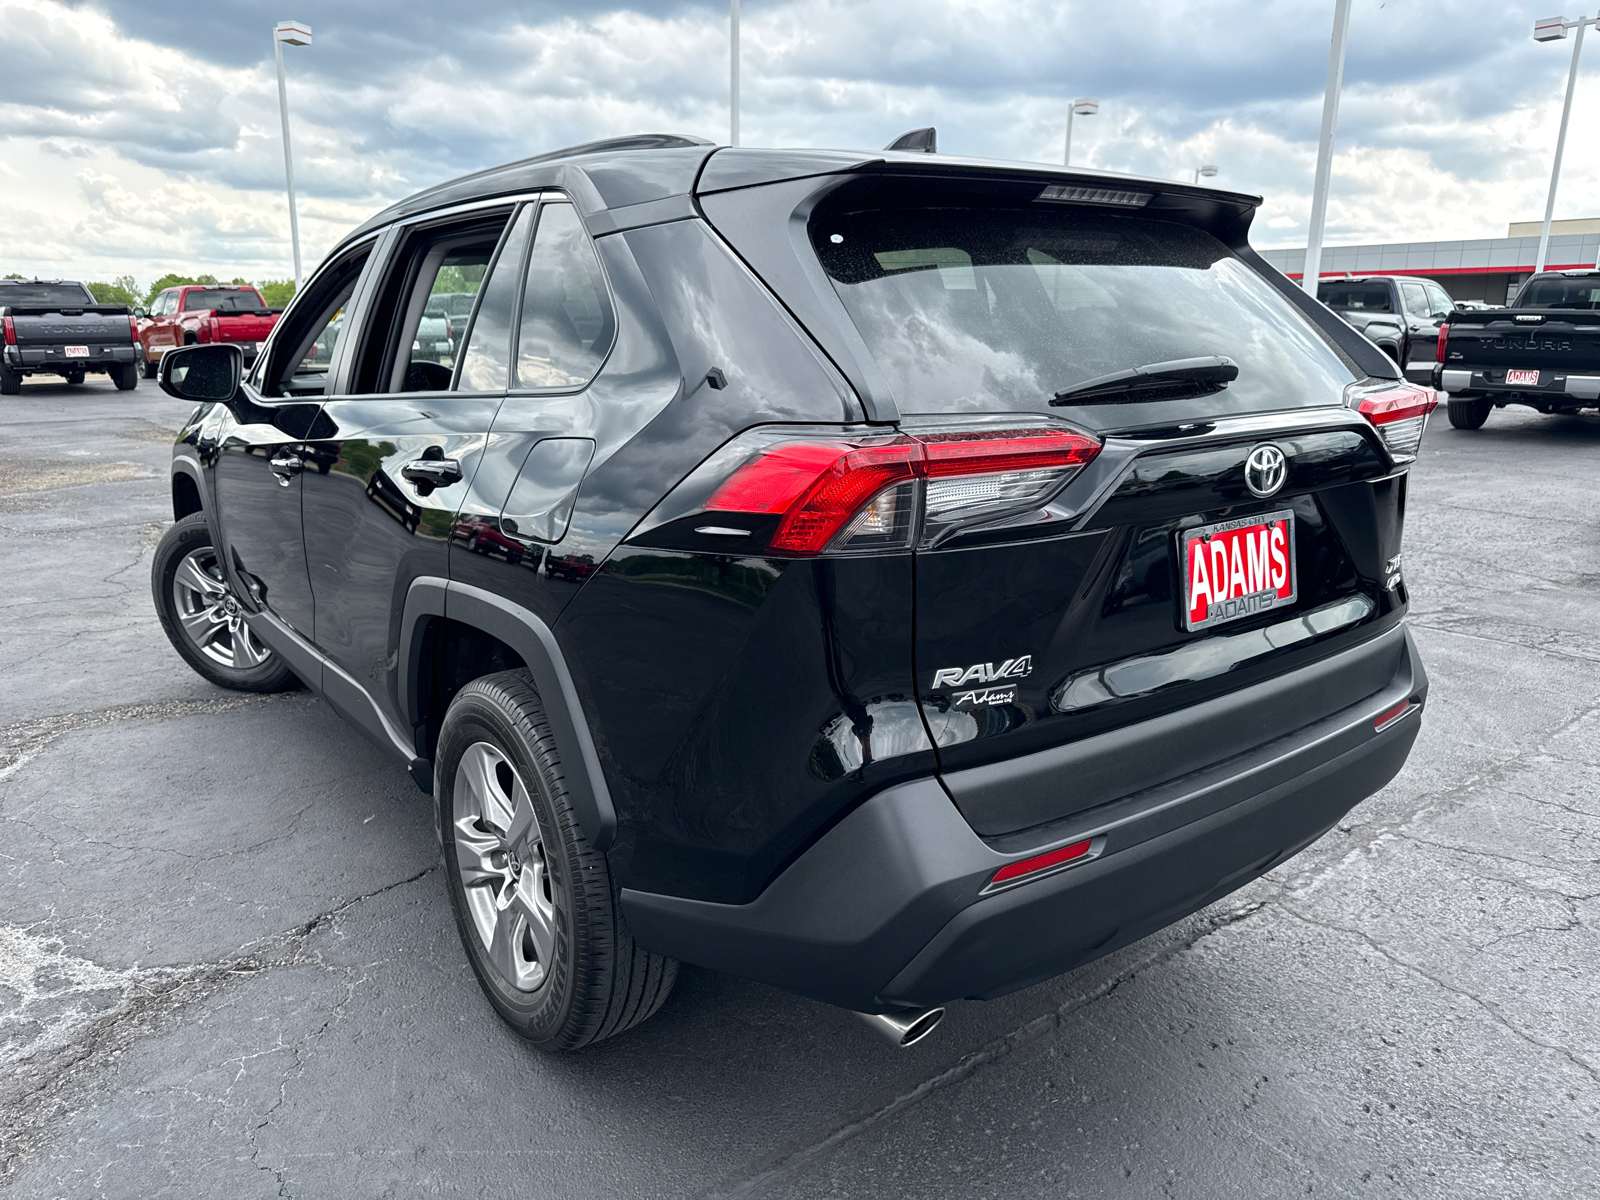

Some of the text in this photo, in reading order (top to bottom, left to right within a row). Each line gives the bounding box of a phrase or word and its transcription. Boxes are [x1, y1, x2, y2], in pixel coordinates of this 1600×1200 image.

[40, 325, 108, 334] TUNDRA
[1479, 337, 1572, 351] TUNDRA
[1508, 370, 1538, 384] ADAMS
[1213, 515, 1267, 533] KANSAS CITY
[1190, 526, 1287, 611] ADAMS
[1213, 590, 1274, 622] ADAMS
[931, 654, 1033, 690] RAV4
[955, 689, 1015, 705] Adams
